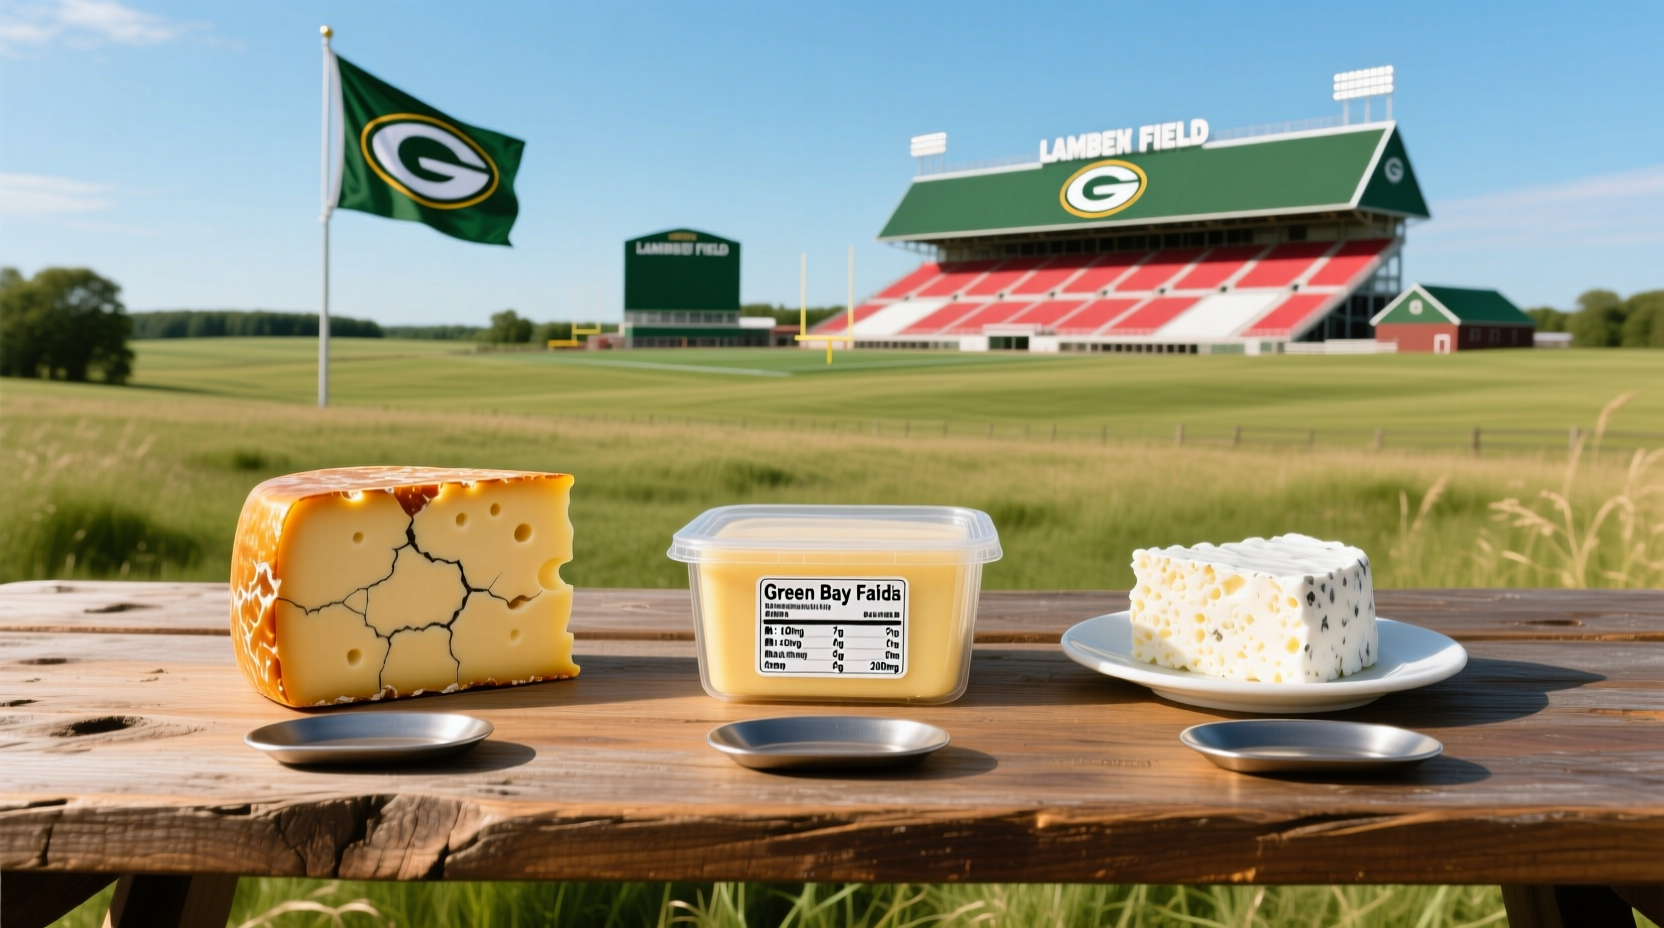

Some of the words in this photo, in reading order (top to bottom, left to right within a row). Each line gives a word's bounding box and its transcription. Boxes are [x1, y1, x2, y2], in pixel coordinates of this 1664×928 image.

[1139, 118, 1209, 153] FIELD
[371, 123, 490, 200] G
[1066, 165, 1140, 212] G
[764, 583, 815, 601] Green
[820, 584, 851, 606] Bay
